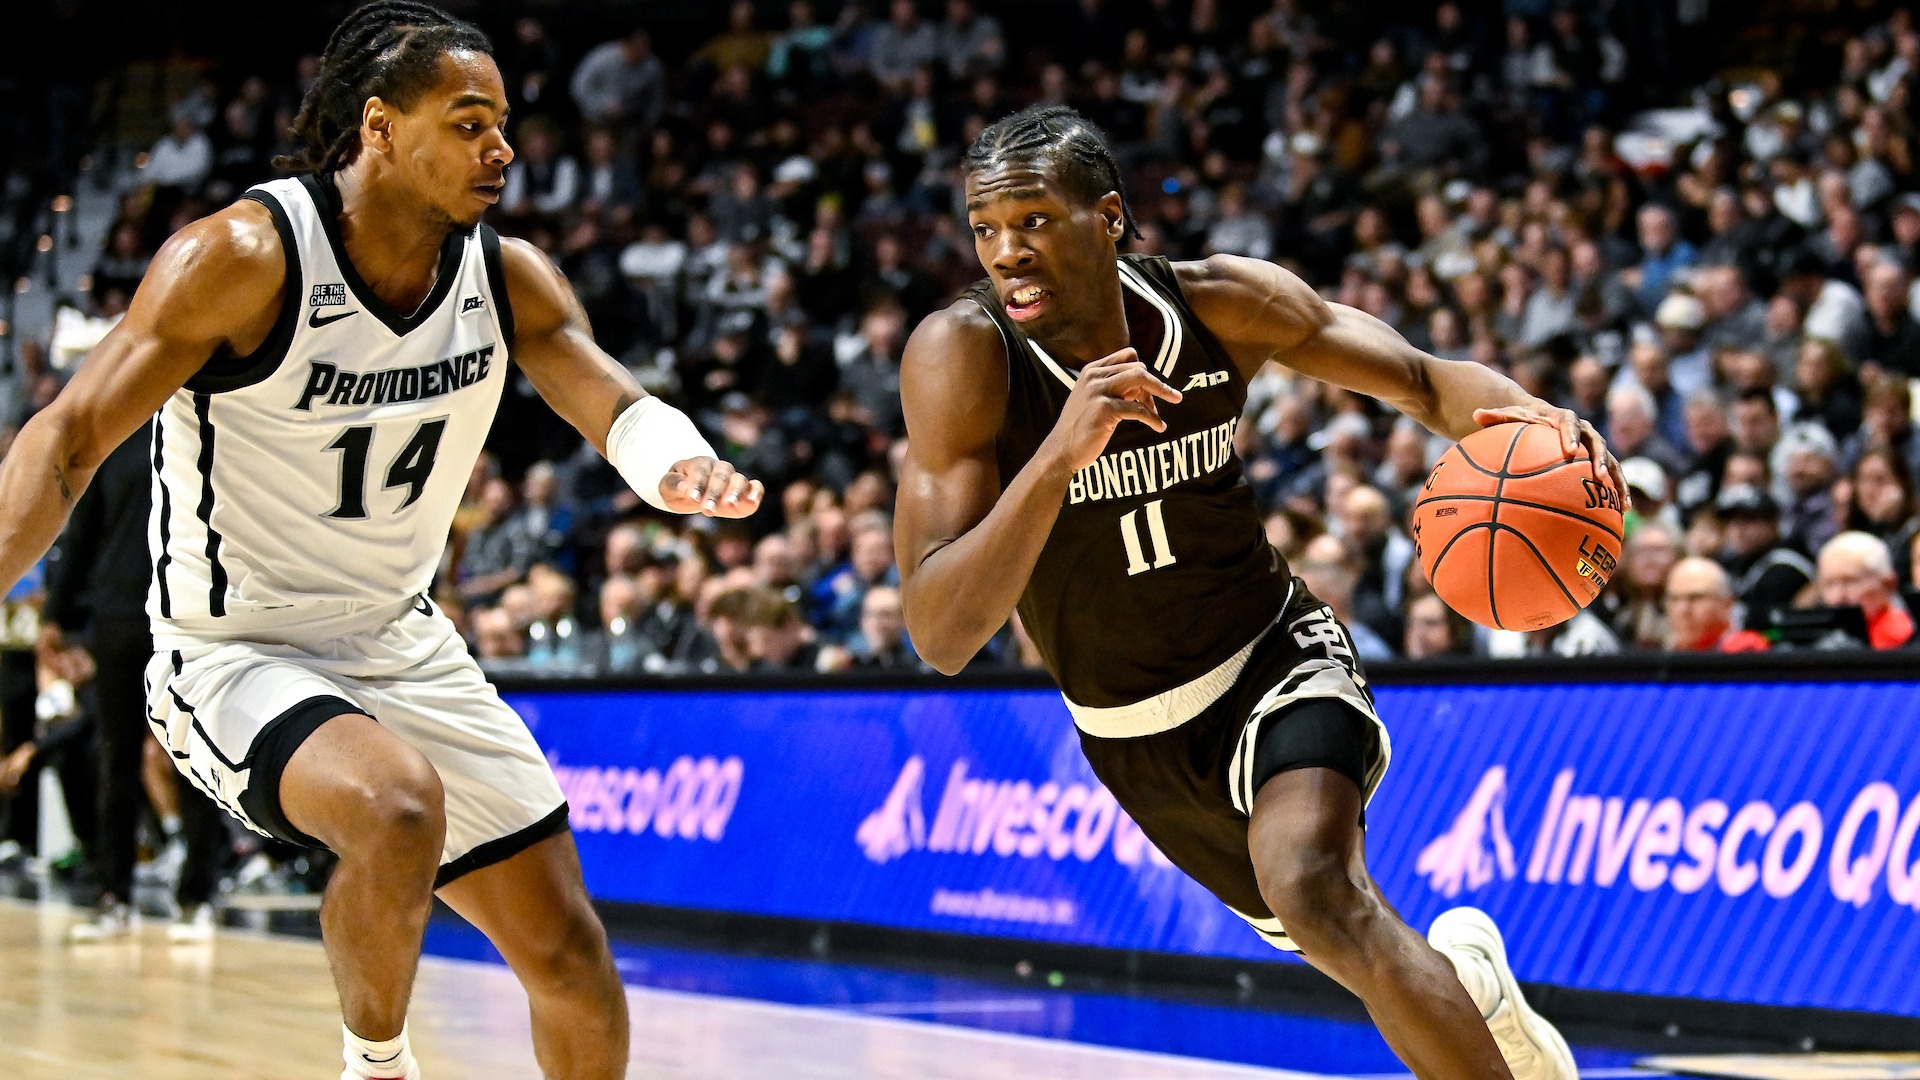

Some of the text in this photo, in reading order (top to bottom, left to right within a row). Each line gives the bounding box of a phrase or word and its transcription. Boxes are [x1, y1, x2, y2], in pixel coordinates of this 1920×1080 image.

[310, 295, 345, 306] CHANGE
[314, 285, 344, 295] BE THE
[291, 342, 495, 411] PROVIDENCE
[1181, 370, 1229, 391] A10
[319, 414, 450, 519] 14
[1120, 500, 1176, 576] 11
[1579, 559, 1593, 575] TF
[547, 749, 662, 835] nvesco
[928, 756, 1117, 862] Invesco
[1525, 766, 1824, 899] Invesco
